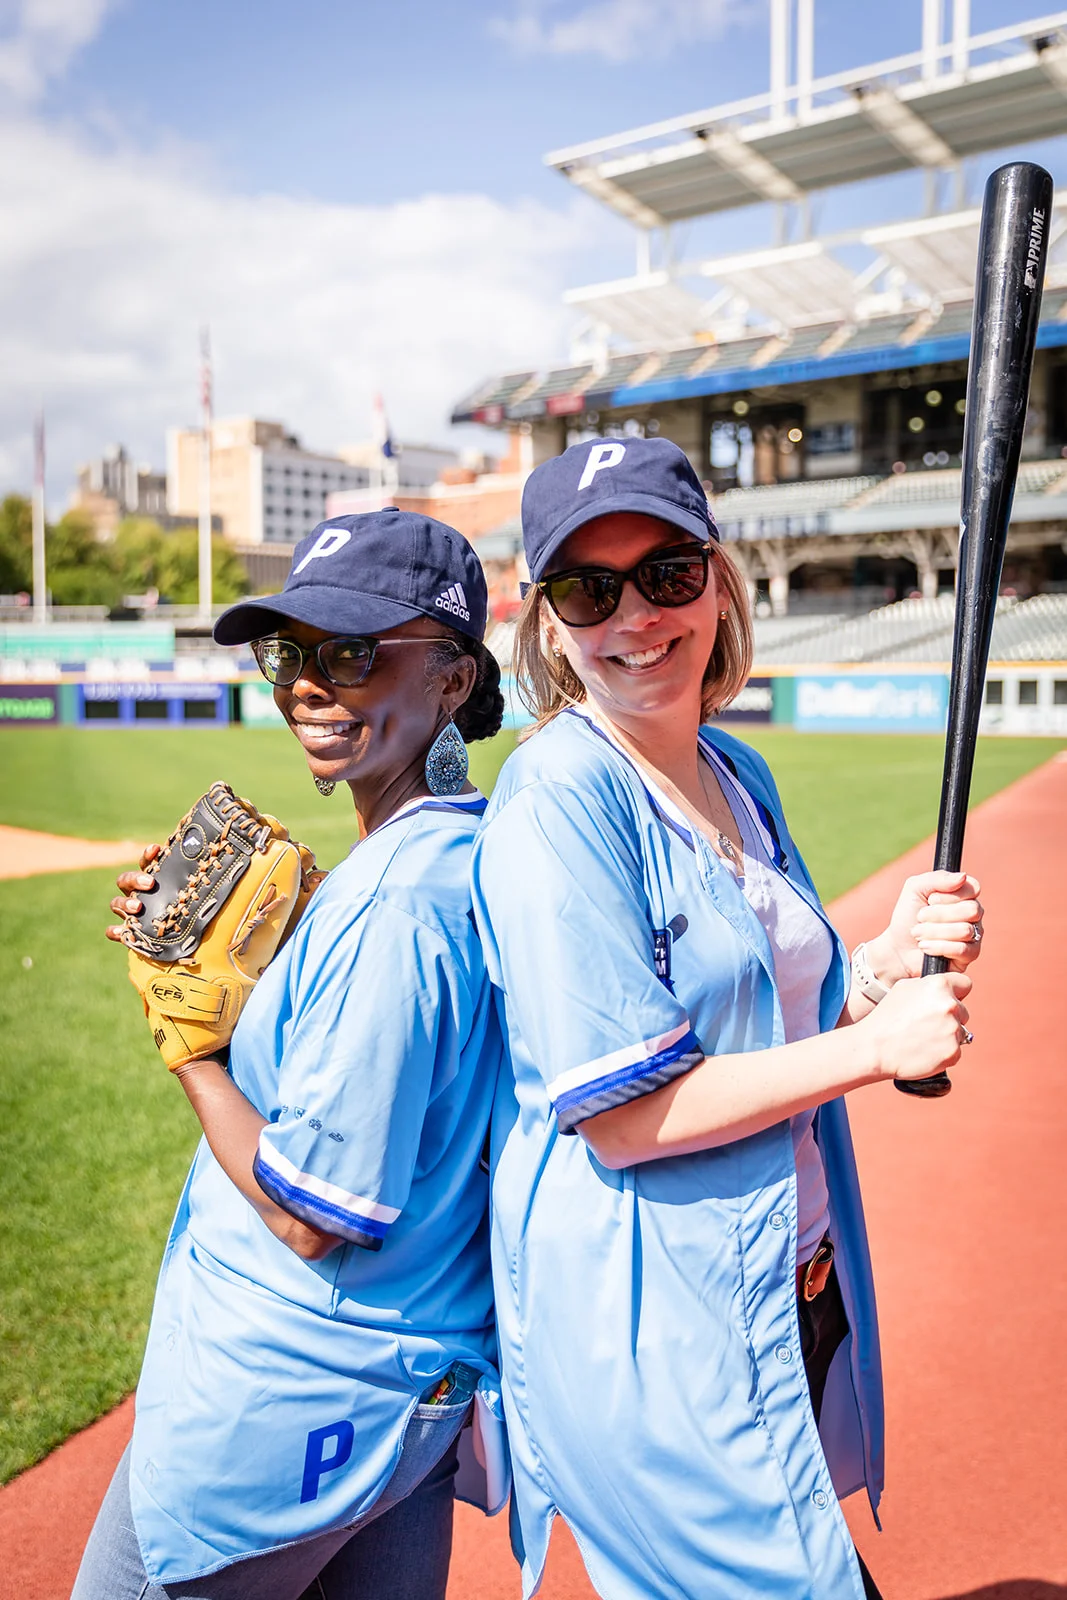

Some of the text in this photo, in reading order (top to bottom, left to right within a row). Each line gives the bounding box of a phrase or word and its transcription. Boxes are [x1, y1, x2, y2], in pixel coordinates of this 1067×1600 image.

[1028, 207, 1045, 262] PRIME
[578, 443, 626, 491] P
[293, 528, 351, 575] P
[435, 597, 470, 622] adidas
[154, 987, 183, 999] CFS
[300, 1419, 354, 1504] P
